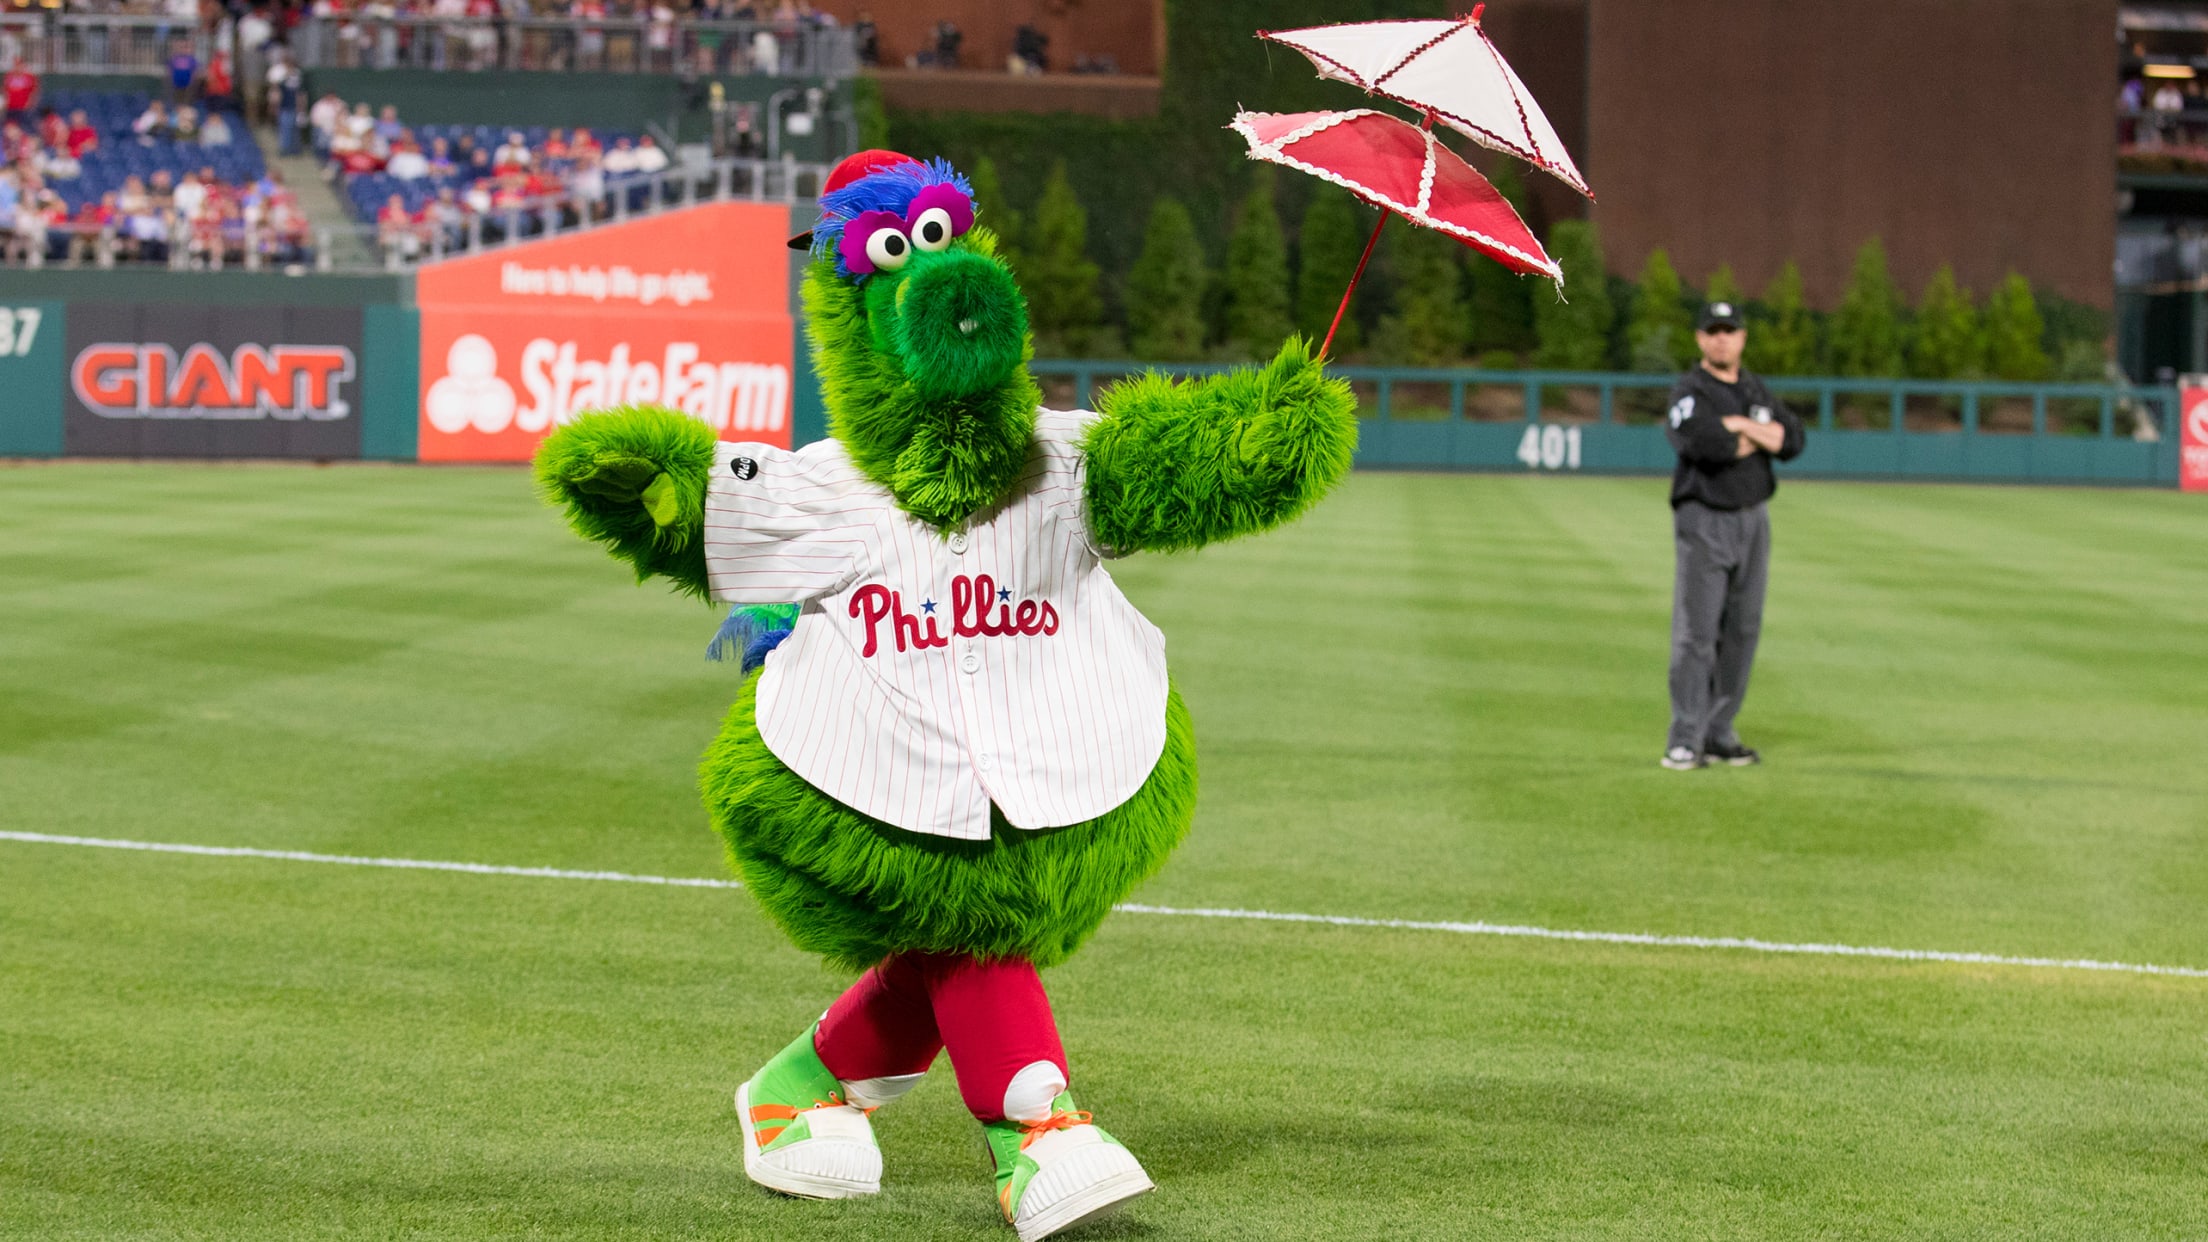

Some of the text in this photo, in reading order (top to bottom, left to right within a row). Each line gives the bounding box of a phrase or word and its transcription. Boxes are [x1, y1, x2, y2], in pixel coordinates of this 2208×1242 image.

[548, 266, 567, 295] to
[71, 342, 356, 420] GIANT
[737, 457, 751, 480] DPM
[1517, 424, 1582, 469] 401
[848, 573, 1060, 658] Phillies
